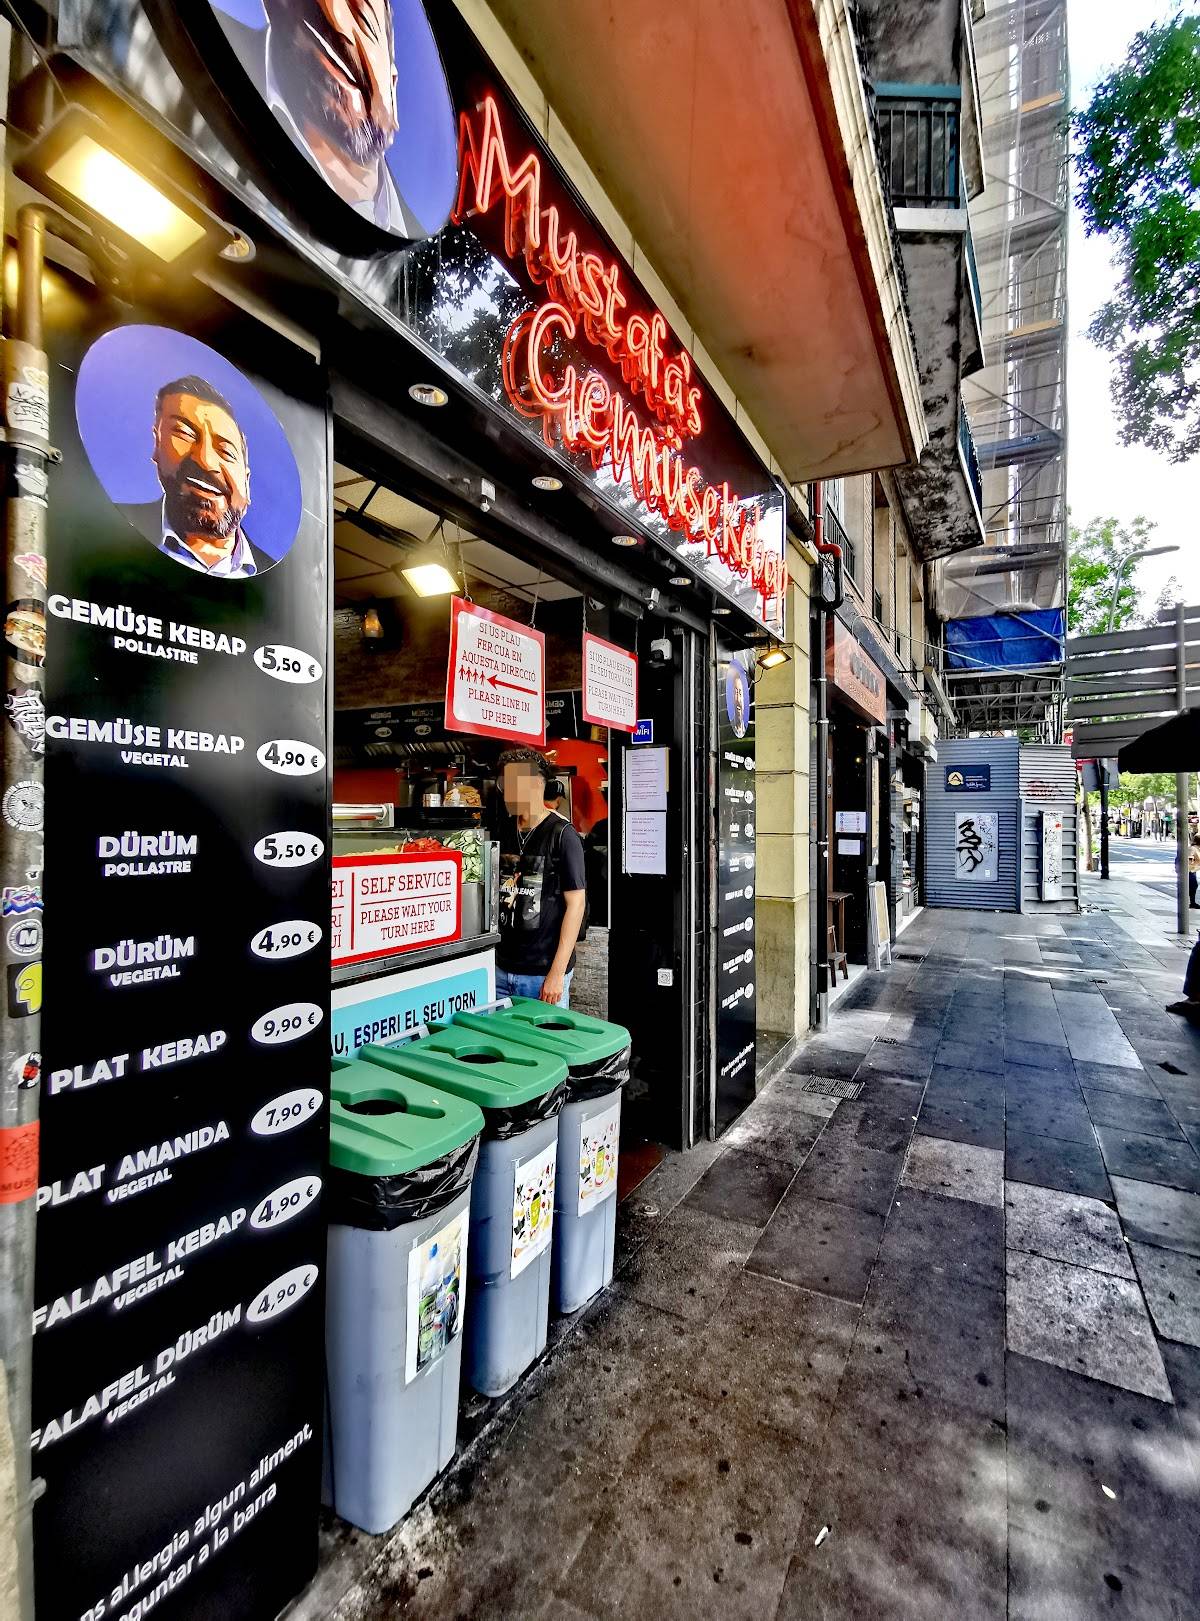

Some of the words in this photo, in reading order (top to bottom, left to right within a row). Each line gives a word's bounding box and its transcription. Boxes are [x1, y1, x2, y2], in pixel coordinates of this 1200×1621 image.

[460, 96, 702, 435] Mustafa's
[515, 302, 719, 542] Gemüse
[47, 594, 163, 639] GEMÜSE
[168, 621, 248, 656] KEBAP
[479, 623, 487, 634] SI
[489, 624, 500, 639] US
[501, 630, 521, 646] PLAU
[113, 636, 199, 665] POLLASTRE
[261, 647, 302, 675] 5,50
[307, 663, 316, 678] €
[462, 649, 500, 671] AQUESTA
[501, 662, 537, 682] DIRECCIÓ
[477, 638, 493, 653] FER
[494, 644, 510, 659] CUA
[512, 651, 522, 663] EN
[602, 656, 616, 670] PLAU
[597, 666, 608, 678] SEU
[468, 687, 501, 705] PLEASE
[502, 696, 520, 710] LINE
[521, 702, 530, 712] IN
[588, 685, 608, 700] PLEASE
[608, 691, 621, 704] WAIT
[482, 709, 494, 720] UP
[495, 712, 517, 725] HERE
[45, 715, 161, 746] GEMÜSE
[167, 728, 245, 755] KEBAP
[120, 751, 189, 768] VEGETAL
[264, 743, 306, 767] 4,90
[310, 754, 318, 767] €
[98, 831, 199, 859] DÜRÜM
[263, 837, 306, 860] 5,50
[310, 843, 319, 857] €
[104, 860, 191, 877] POLLASTRE
[361, 876, 396, 896] SELF
[398, 871, 452, 891] SERVICE
[361, 907, 400, 924] PLEASE
[402, 903, 426, 918] WAIT
[427, 900, 452, 914] YOUR
[258, 930, 302, 953] 4,90
[306, 930, 315, 943] €
[381, 923, 408, 940] TURN
[410, 919, 436, 935] HERE
[93, 935, 196, 971] DÜRÜM
[110, 964, 181, 987] VEGETAL
[263, 1015, 302, 1037] 9,90
[307, 1011, 315, 1025] €
[331, 1032, 349, 1057] U,
[354, 1014, 401, 1049] ESPERI
[405, 1009, 420, 1030] EL
[423, 1002, 445, 1024] SEU
[449, 990, 476, 1018] TORN
[50, 1054, 129, 1095] PLAT
[142, 1030, 227, 1071] KEBAP
[265, 1103, 302, 1127] 7,90
[307, 1097, 315, 1110] €
[35, 1164, 106, 1211] PLAT
[117, 1121, 230, 1181] AMANIDA
[107, 1168, 172, 1203] VEGETAL
[257, 1192, 301, 1224] 4,90
[306, 1183, 314, 1197] €
[32, 1252, 161, 1335] FALAFEL
[168, 1207, 247, 1264] KEBAP
[113, 1264, 184, 1311] VEGETAL
[256, 1284, 296, 1315] 4,90
[303, 1273, 311, 1287] €
[156, 1303, 242, 1375] DÜRÜM
[106, 1371, 176, 1425] VEGETAL
[194, 1481, 246, 1537] algun
[249, 1422, 313, 1490] aliment,
[198, 1543, 210, 1564] a
[213, 1526, 229, 1552] la
[233, 1482, 277, 1533] barra
